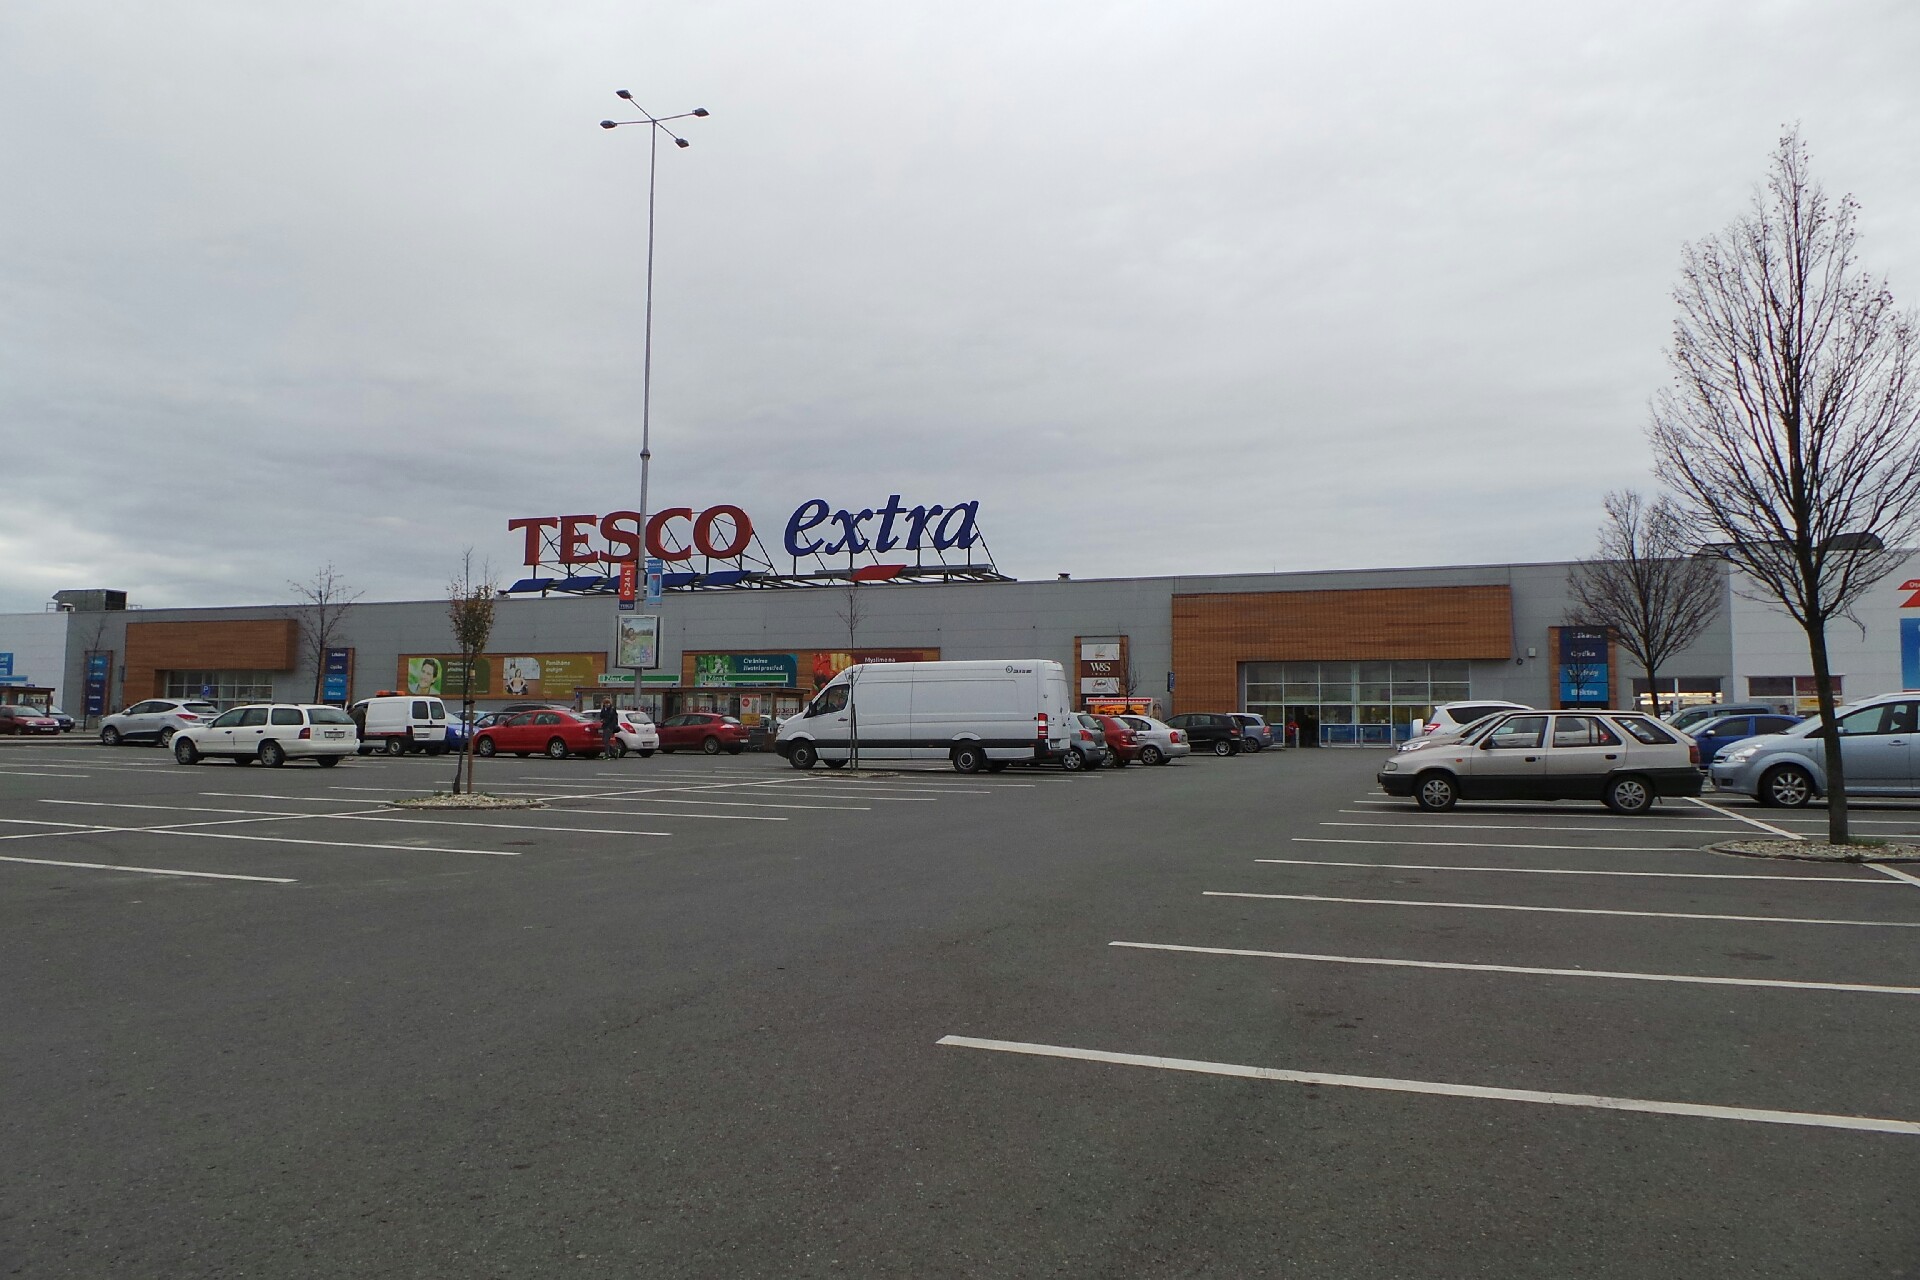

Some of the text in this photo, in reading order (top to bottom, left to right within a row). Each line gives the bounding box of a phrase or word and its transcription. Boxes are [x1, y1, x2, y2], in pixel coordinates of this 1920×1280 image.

[508, 494, 979, 566] TESCO extra
[1090, 662, 1111, 672] W&S
